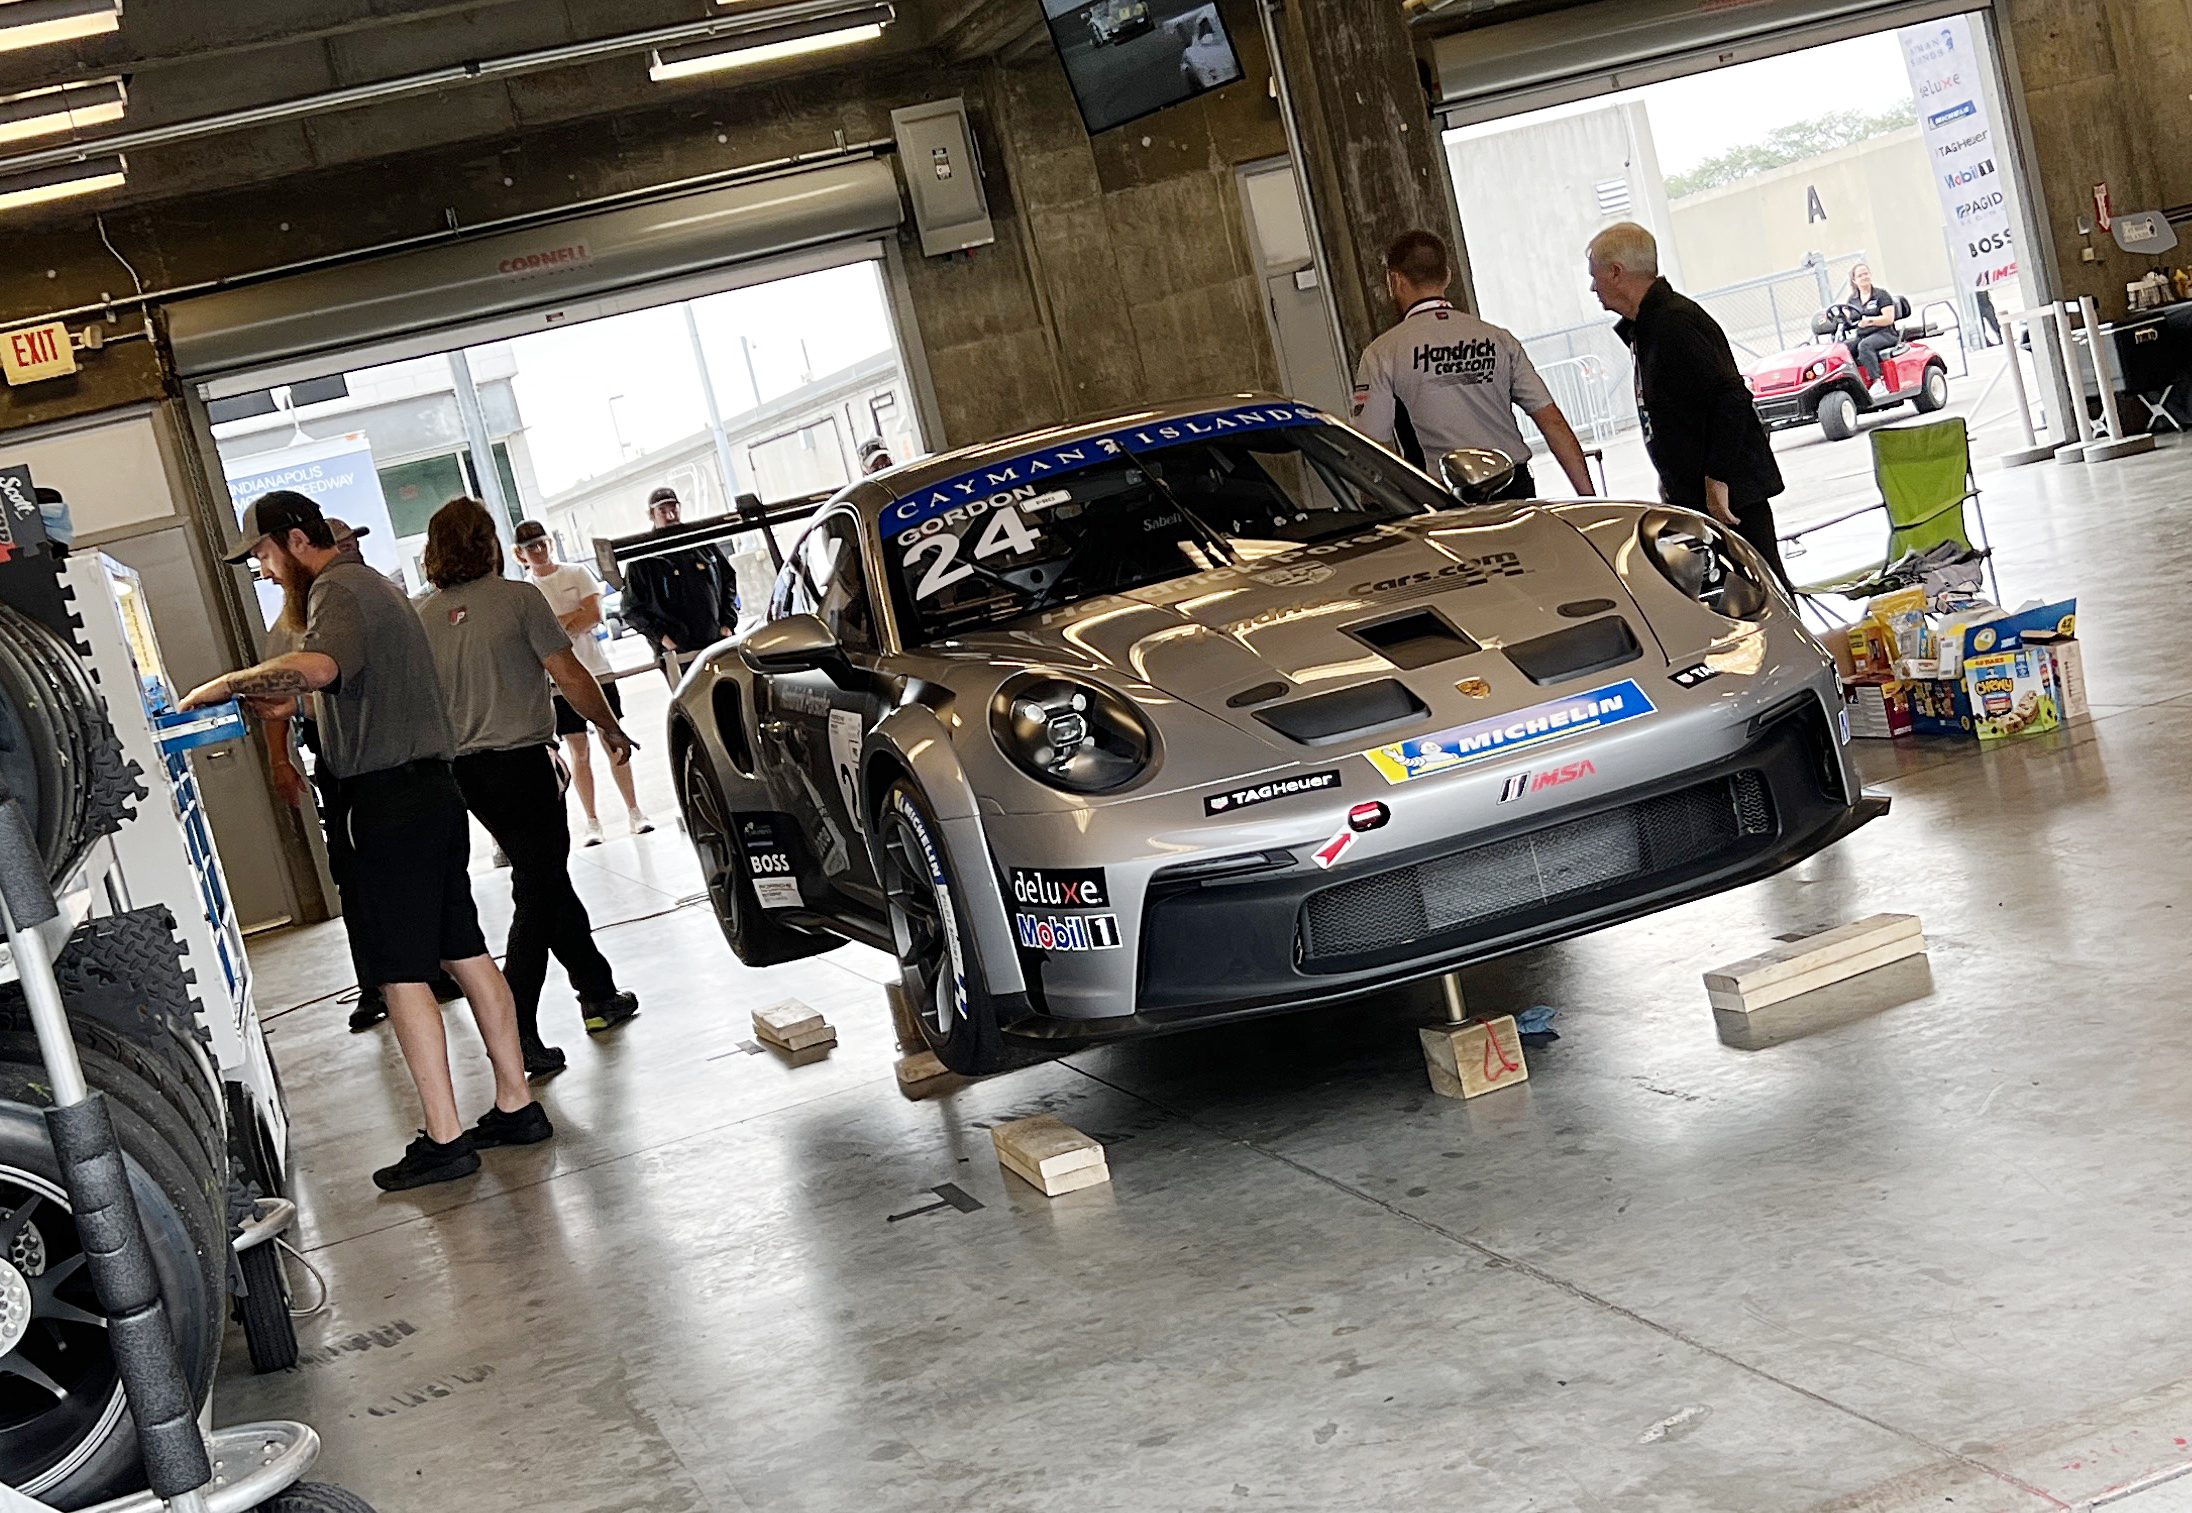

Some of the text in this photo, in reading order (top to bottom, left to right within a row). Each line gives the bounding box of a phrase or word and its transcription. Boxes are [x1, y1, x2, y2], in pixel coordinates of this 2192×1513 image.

[1944, 164, 1980, 189] Mobil
[1807, 185, 1827, 224] A
[1964, 191, 2004, 215] PAGID
[498, 245, 590, 273] CORNELL
[1992, 262, 2018, 282] IMS
[11, 328, 58, 368] EXIT
[1413, 337, 1497, 373] Hendrick
[228, 465, 323, 499] INDIANAPOLIS
[896, 407, 1317, 520] CAYMAN ISLANDS
[897, 485, 1037, 547] GORDON
[902, 506, 1042, 601] 24
[1458, 694, 1625, 754] MICHELIN
[903, 802, 942, 878] MICHELIN
[749, 853, 791, 874] BOSS
[1015, 912, 1117, 951] Mobil 1
